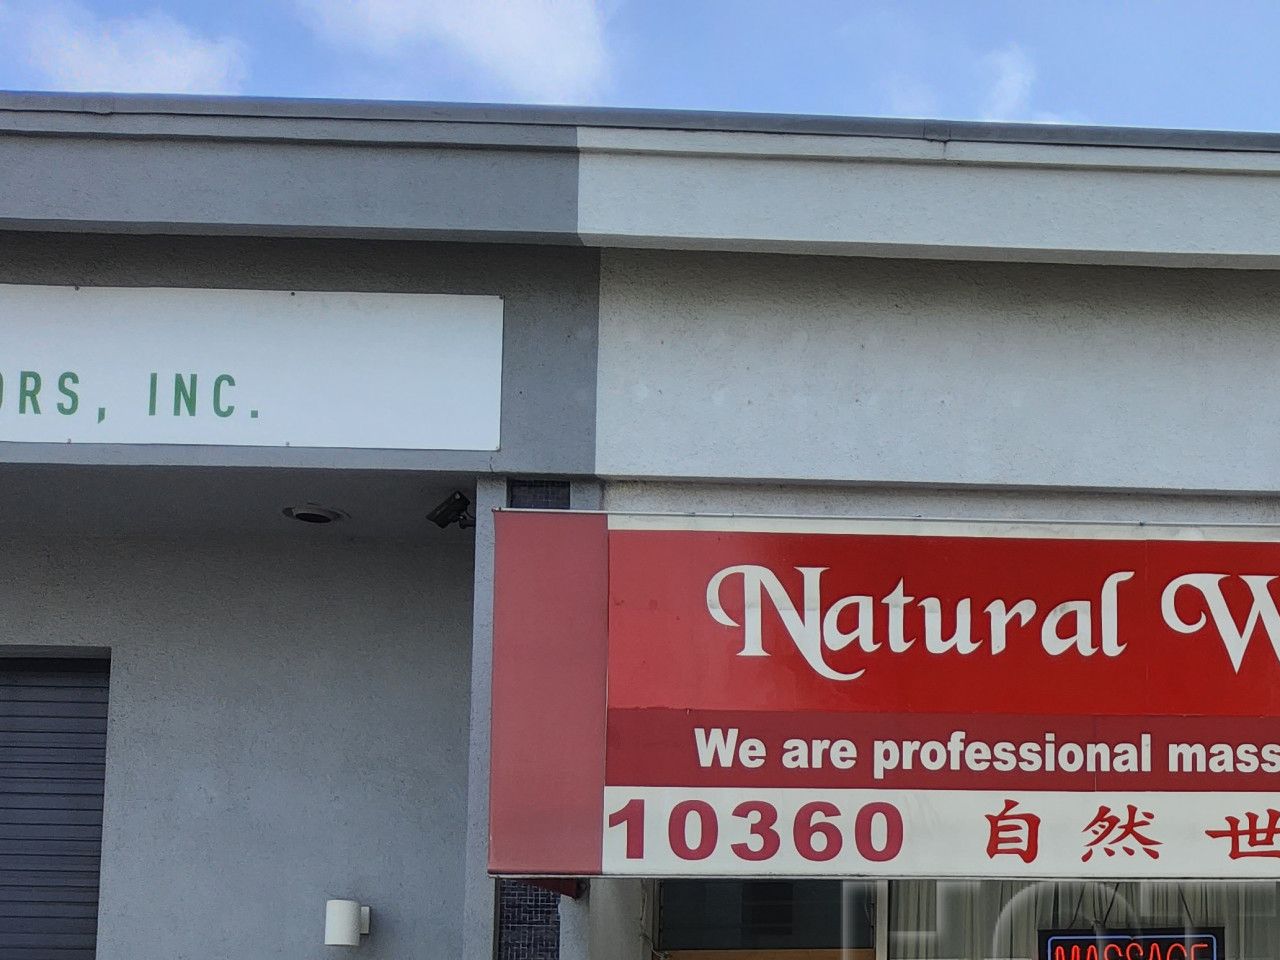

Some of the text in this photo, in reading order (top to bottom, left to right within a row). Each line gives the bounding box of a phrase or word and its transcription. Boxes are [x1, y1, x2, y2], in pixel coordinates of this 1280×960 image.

[0, 370, 260, 424] RS, INC.
[706, 564, 1136, 682] Natural
[694, 727, 766, 769] We
[782, 736, 858, 770] are
[873, 731, 1152, 780] professional
[606, 798, 905, 864] 10360
